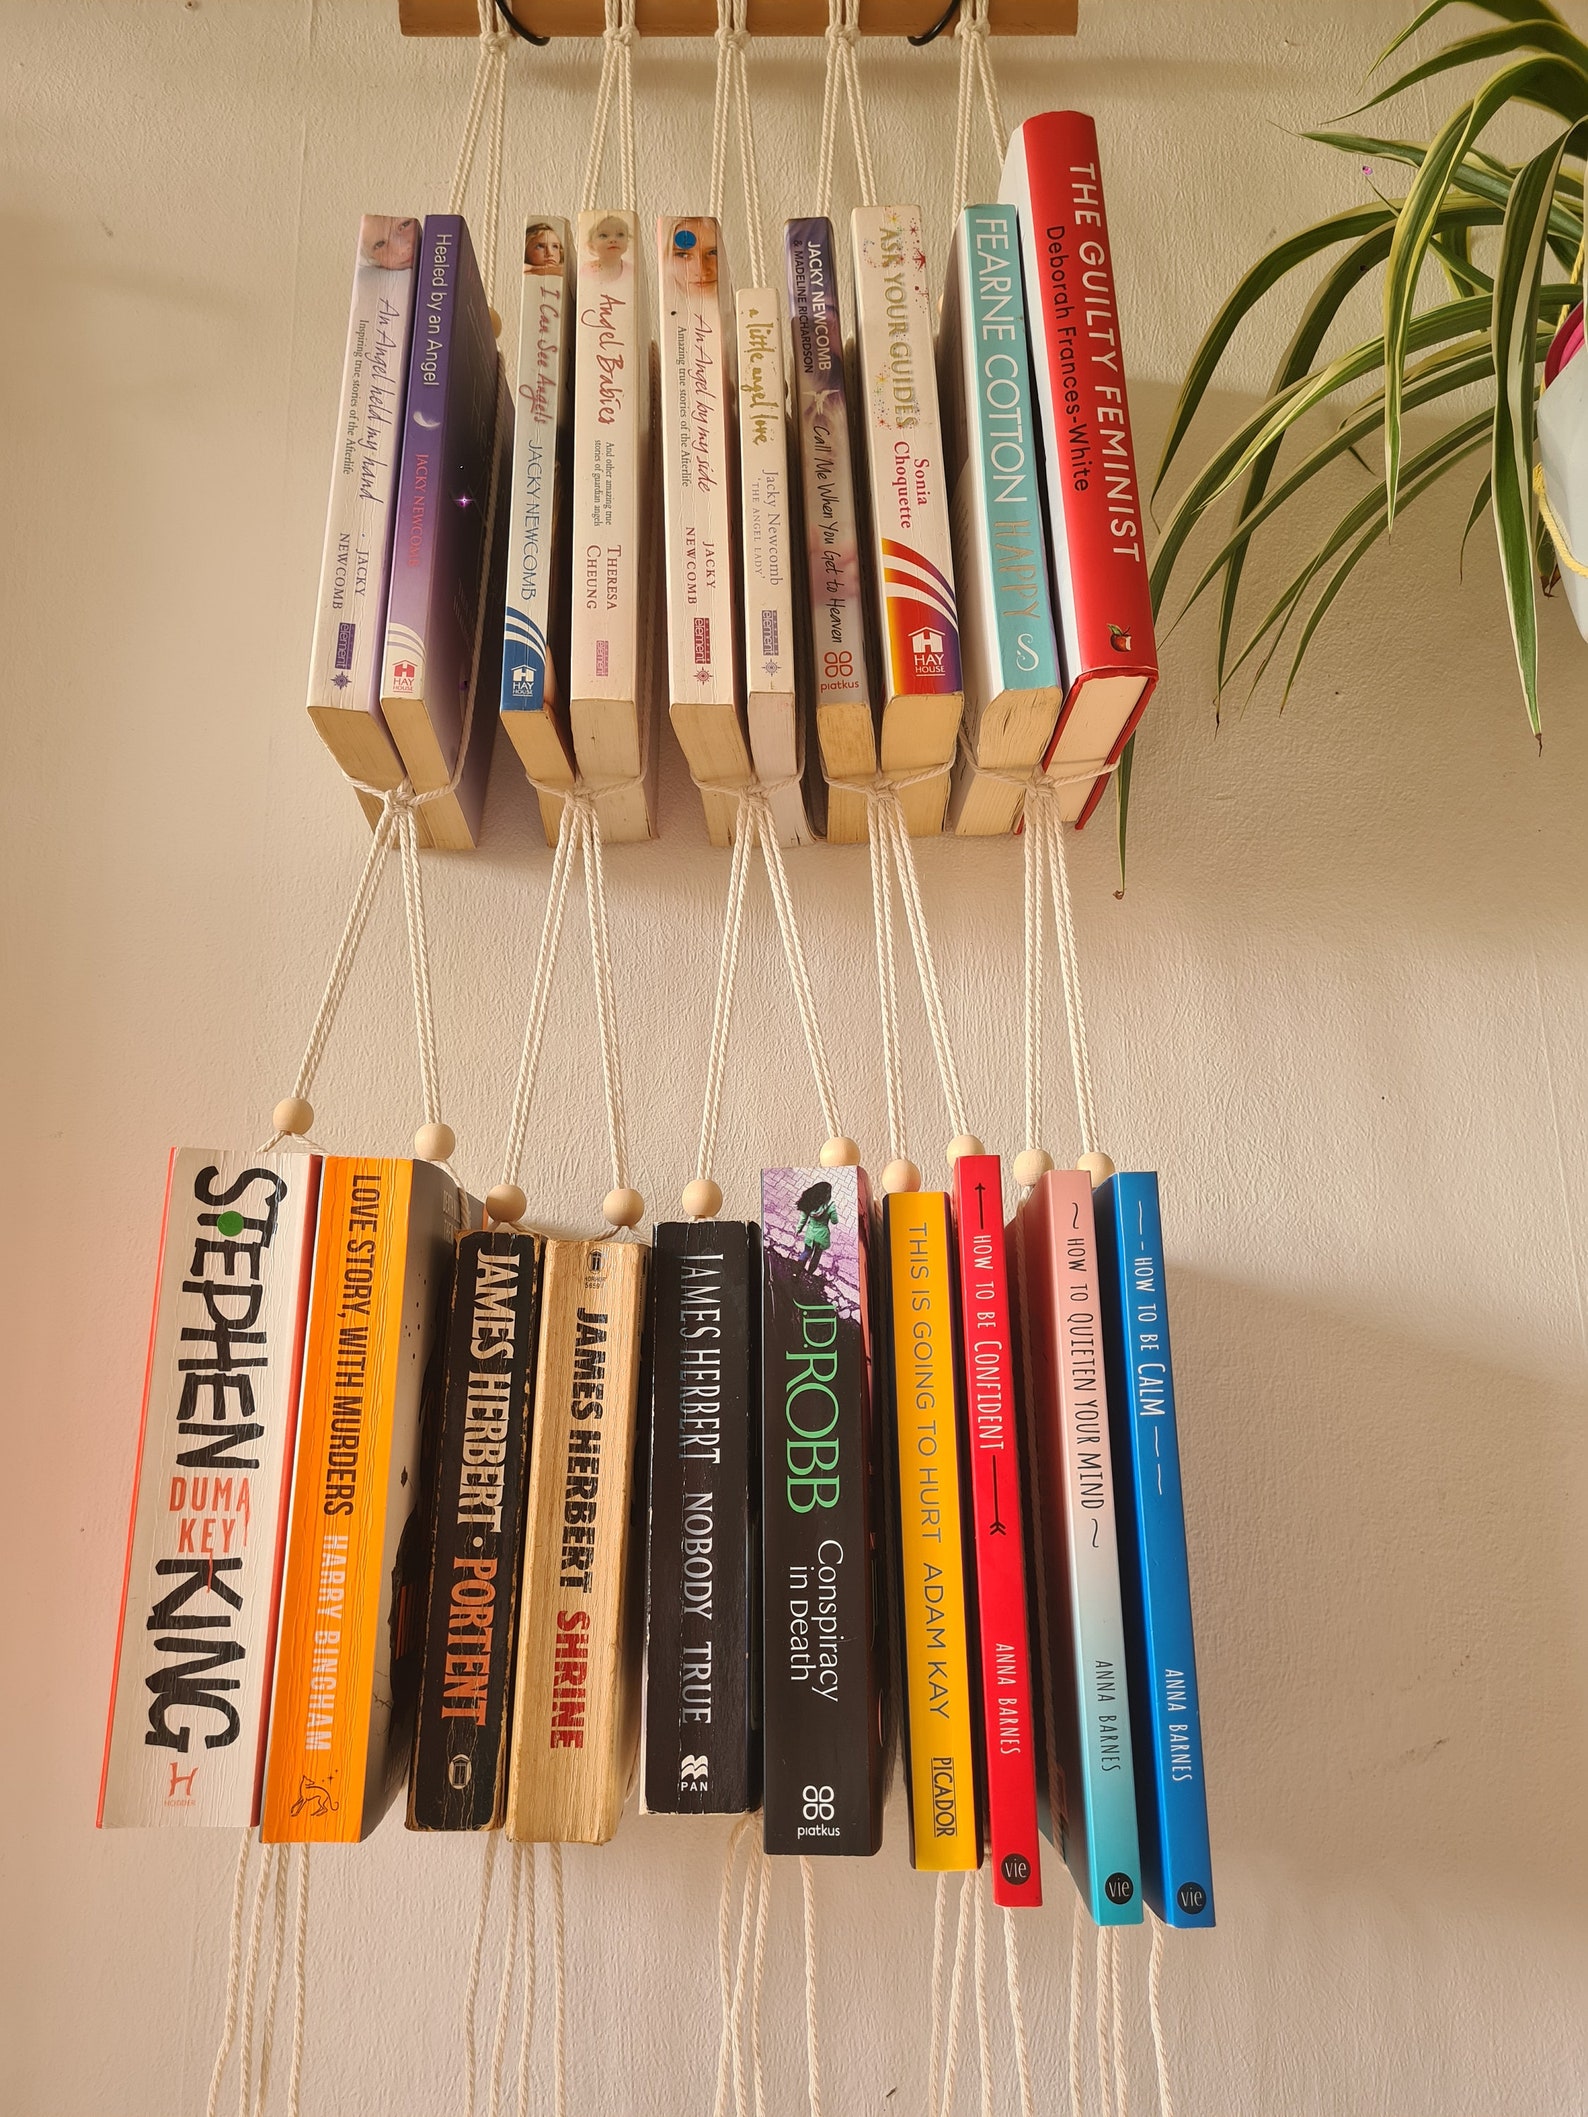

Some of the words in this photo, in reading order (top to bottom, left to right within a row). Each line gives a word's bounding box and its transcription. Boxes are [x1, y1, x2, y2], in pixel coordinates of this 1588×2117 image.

[1070, 162, 1101, 227] THE
[431, 234, 452, 287] Healed
[808, 241, 823, 288] JACKY
[879, 227, 900, 268] ASK
[540, 286, 560, 300] I
[794, 251, 807, 303] MADELINE
[976, 218, 1016, 341] FEARNE
[378, 298, 400, 326] An
[426, 292, 447, 311] by
[538, 304, 559, 334] Can
[581, 294, 626, 350] Angel
[749, 308, 759, 318] a
[884, 273, 909, 337] YOUR
[1079, 240, 1118, 372] GUILTY
[354, 319, 369, 359] Inspiring
[428, 315, 441, 334] an
[675, 326, 687, 365] Amazing
[694, 313, 712, 345] An
[743, 323, 775, 363] little
[798, 306, 813, 373] RICHARDSON
[812, 291, 832, 371] NEWCOMB
[365, 329, 396, 384] Angel
[421, 339, 443, 386] Angel
[537, 339, 557, 369] See
[687, 346, 716, 399] Angel
[1046, 226, 1070, 320] Deborah
[1058, 326, 1093, 491] Frances-White
[350, 378, 361, 408] stories
[369, 385, 395, 425] held
[519, 373, 556, 424] Angels
[596, 354, 624, 425] Babies
[679, 389, 690, 418] stories
[741, 367, 779, 409] angel
[889, 342, 917, 428] GUIDES
[347, 420, 358, 435] the
[350, 409, 359, 419] of
[680, 421, 690, 430] of
[691, 401, 714, 424] by
[750, 414, 779, 446] love
[984, 354, 1027, 503] COTTON
[343, 438, 356, 475] Afterlife
[358, 427, 381, 451] my
[595, 440, 604, 464] stories
[606, 442, 615, 457] And
[681, 431, 690, 447] the
[692, 426, 710, 454] my
[813, 425, 830, 453] Call
[359, 455, 388, 504] hand
[415, 454, 429, 492] JACKY
[527, 440, 543, 499] JACKY
[592, 473, 603, 504] guardian
[606, 459, 614, 478] other
[681, 450, 692, 487] Afterlife
[696, 456, 717, 492] side
[762, 469, 780, 508] Jacky
[816, 456, 834, 480] Me
[892, 441, 911, 529] Choquette
[914, 458, 930, 506] Sonia
[1093, 385, 1141, 562] FEMINIST
[592, 506, 603, 527] angels
[603, 479, 615, 509] amazing
[817, 483, 840, 518] When
[408, 496, 425, 566] NEWCOMB
[752, 508, 761, 542] ANGEL
[819, 521, 839, 544] You
[332, 533, 350, 609] NEWCOMB
[521, 503, 539, 600] NEWCOMB
[686, 527, 697, 604] NEWCOMB
[703, 541, 716, 589] JACKY
[768, 513, 783, 586] Newcomb
[820, 550, 844, 578] Get
[992, 520, 1041, 620] HAPPY
[355, 549, 369, 597] JACKY
[586, 545, 601, 609] CHEUNG
[606, 545, 621, 610] THERESA
[827, 579, 845, 593] to
[695, 618, 705, 662] element
[763, 611, 773, 654] element
[825, 598, 846, 643] Heaven
[335, 623, 349, 669] element
[914, 654, 945, 666] HAY
[820, 680, 860, 693] piatkus
[348, 1174, 381, 1233] LOVE
[909, 1222, 929, 1279] THIS
[973, 1235, 993, 1270] HOW
[1067, 1238, 1087, 1272] HOW
[337, 1239, 377, 1319] STORY,
[676, 1253, 724, 1339] JAMES
[975, 1281, 995, 1300] TO
[1070, 1283, 1088, 1302] TO
[1134, 1257, 1155, 1292] HOW
[176, 1165, 287, 1469] STEPHEN
[470, 1248, 521, 1360] JAMES
[912, 1290, 931, 1311] IS
[977, 1311, 996, 1329] BE
[1137, 1303, 1157, 1322] TO
[335, 1326, 368, 1387] WITH
[570, 1307, 608, 1421] JAMES
[1067, 1313, 1097, 1392] QUIETEN
[1139, 1334, 1160, 1351] BE
[912, 1321, 935, 1410] GOING
[678, 1349, 721, 1464] HERBERT
[974, 1341, 1004, 1450] CONFIDENT
[1137, 1363, 1166, 1417] CALM
[917, 1420, 937, 1457] TO
[1074, 1399, 1100, 1445] YOUR
[323, 1395, 364, 1517] MURDERS
[456, 1370, 512, 1533] HERBERT
[169, 1477, 250, 1512] DUMA
[1077, 1453, 1105, 1509] MIND
[560, 1429, 601, 1594] HERBERT
[919, 1468, 941, 1544] HURT
[178, 1518, 236, 1553] KEY
[682, 1491, 713, 1621] NOBODY
[318, 1535, 349, 1620] HARRY
[789, 1566, 815, 1589] in
[811, 1539, 845, 1702] Conspiracy
[923, 1562, 946, 1648] ADAM
[144, 1557, 247, 1754] KING
[441, 1556, 498, 1726] PORTENT
[789, 1599, 817, 1681] Death
[550, 1610, 591, 1750] SHRINE
[682, 1641, 712, 1724] TRUE
[996, 1643, 1017, 1686] ANNA
[1095, 1660, 1115, 1702] ANNA
[305, 1631, 343, 1751] BINGHAM
[928, 1661, 950, 1719] KAY
[1165, 1668, 1187, 1712] ANNA
[998, 1698, 1021, 1755] BARNES
[1098, 1715, 1120, 1772] BARNES
[1168, 1724, 1193, 1782] BARNES
[681, 1781, 708, 1792] PAN
[933, 1757, 955, 1838] PICADOR
[797, 1825, 841, 1839] piatkus
[1005, 1859, 1027, 1879] vie
[1109, 1877, 1130, 1898] vie
[1180, 1886, 1203, 1907] vie
